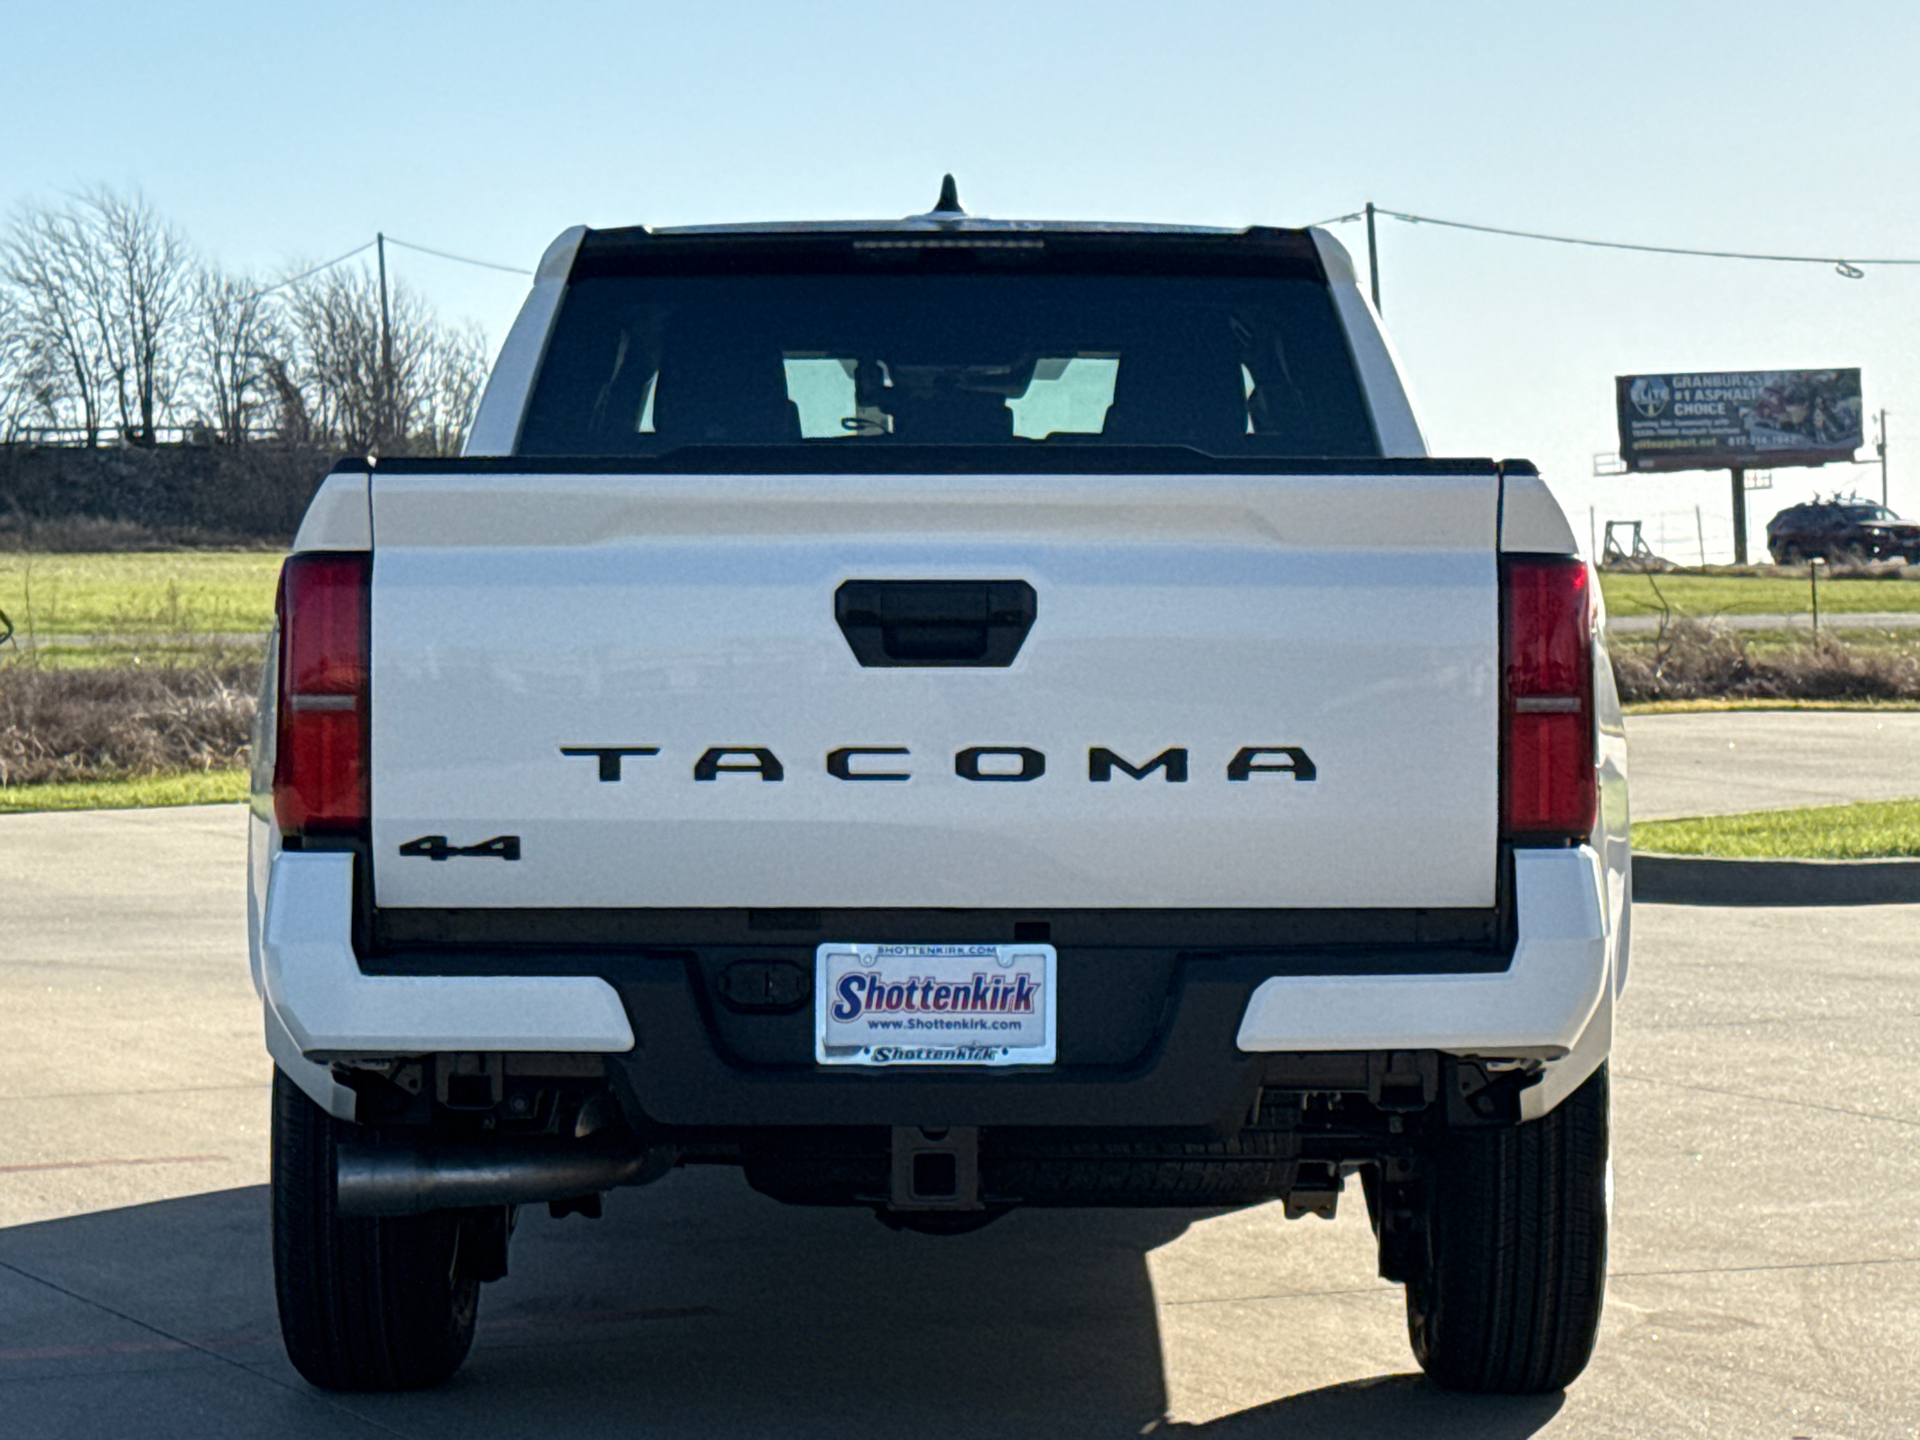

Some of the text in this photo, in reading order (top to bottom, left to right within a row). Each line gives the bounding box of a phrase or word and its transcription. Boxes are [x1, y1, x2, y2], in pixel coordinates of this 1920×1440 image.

[1674, 388, 1757, 402] #1 ASPHALT
[1674, 402, 1727, 417] CHOICE
[559, 746, 1317, 783] TACOMA
[877, 945, 998, 956] SHOTTENKIRK.COM
[831, 972, 1040, 1023] Shottenkirk
[867, 1017, 1023, 1032] www.Shottenkirk.com
[871, 1046, 996, 1062] Shottenkirk
